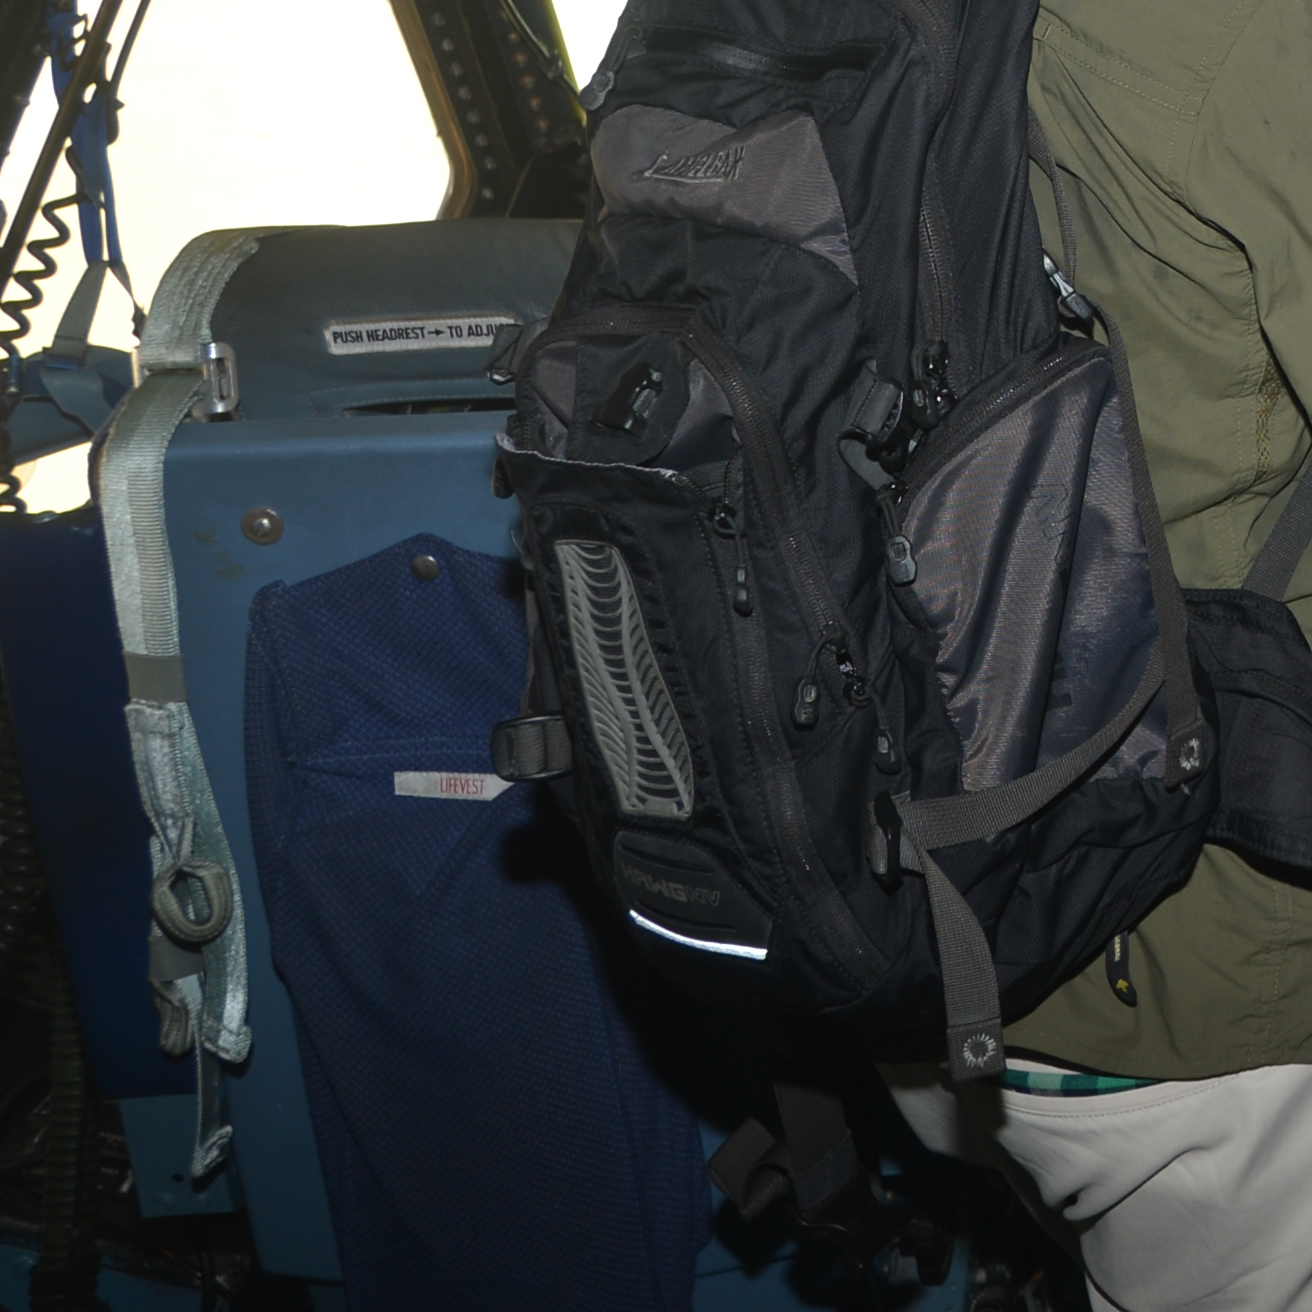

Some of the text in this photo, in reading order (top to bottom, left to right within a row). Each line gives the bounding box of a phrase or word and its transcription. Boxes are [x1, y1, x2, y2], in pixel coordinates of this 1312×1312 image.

[332, 323, 499, 345] PUSH HEADREST TO ADJU
